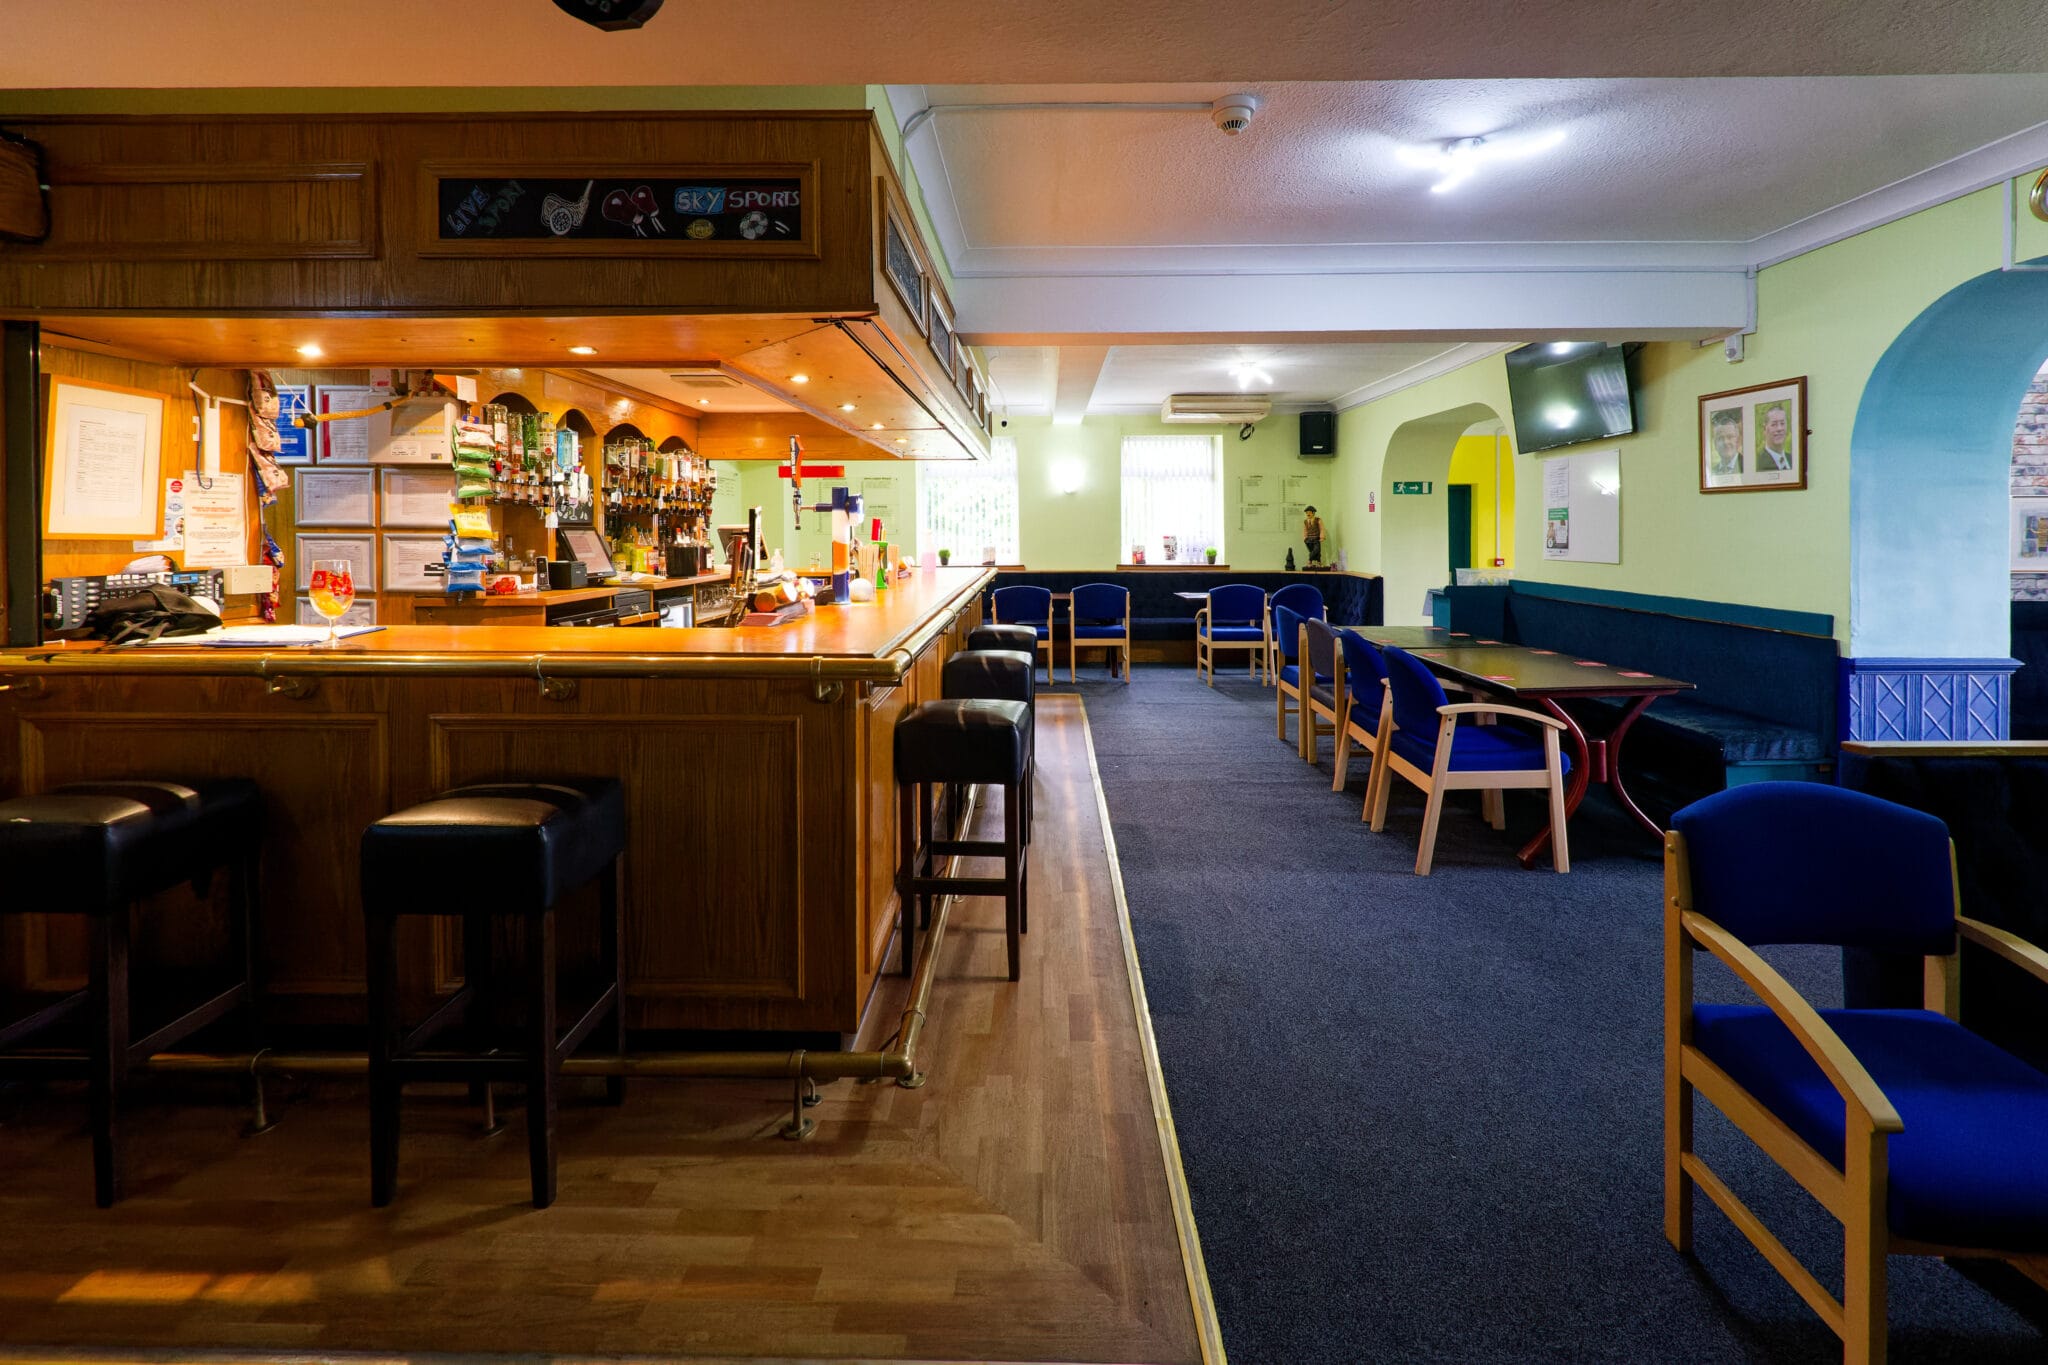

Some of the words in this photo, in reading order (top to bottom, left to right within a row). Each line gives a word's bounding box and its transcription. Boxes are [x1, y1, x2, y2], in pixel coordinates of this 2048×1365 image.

[446, 184, 490, 236] LIVE
[677, 191, 721, 213] SKY
[729, 190, 800, 209] SPORTS
